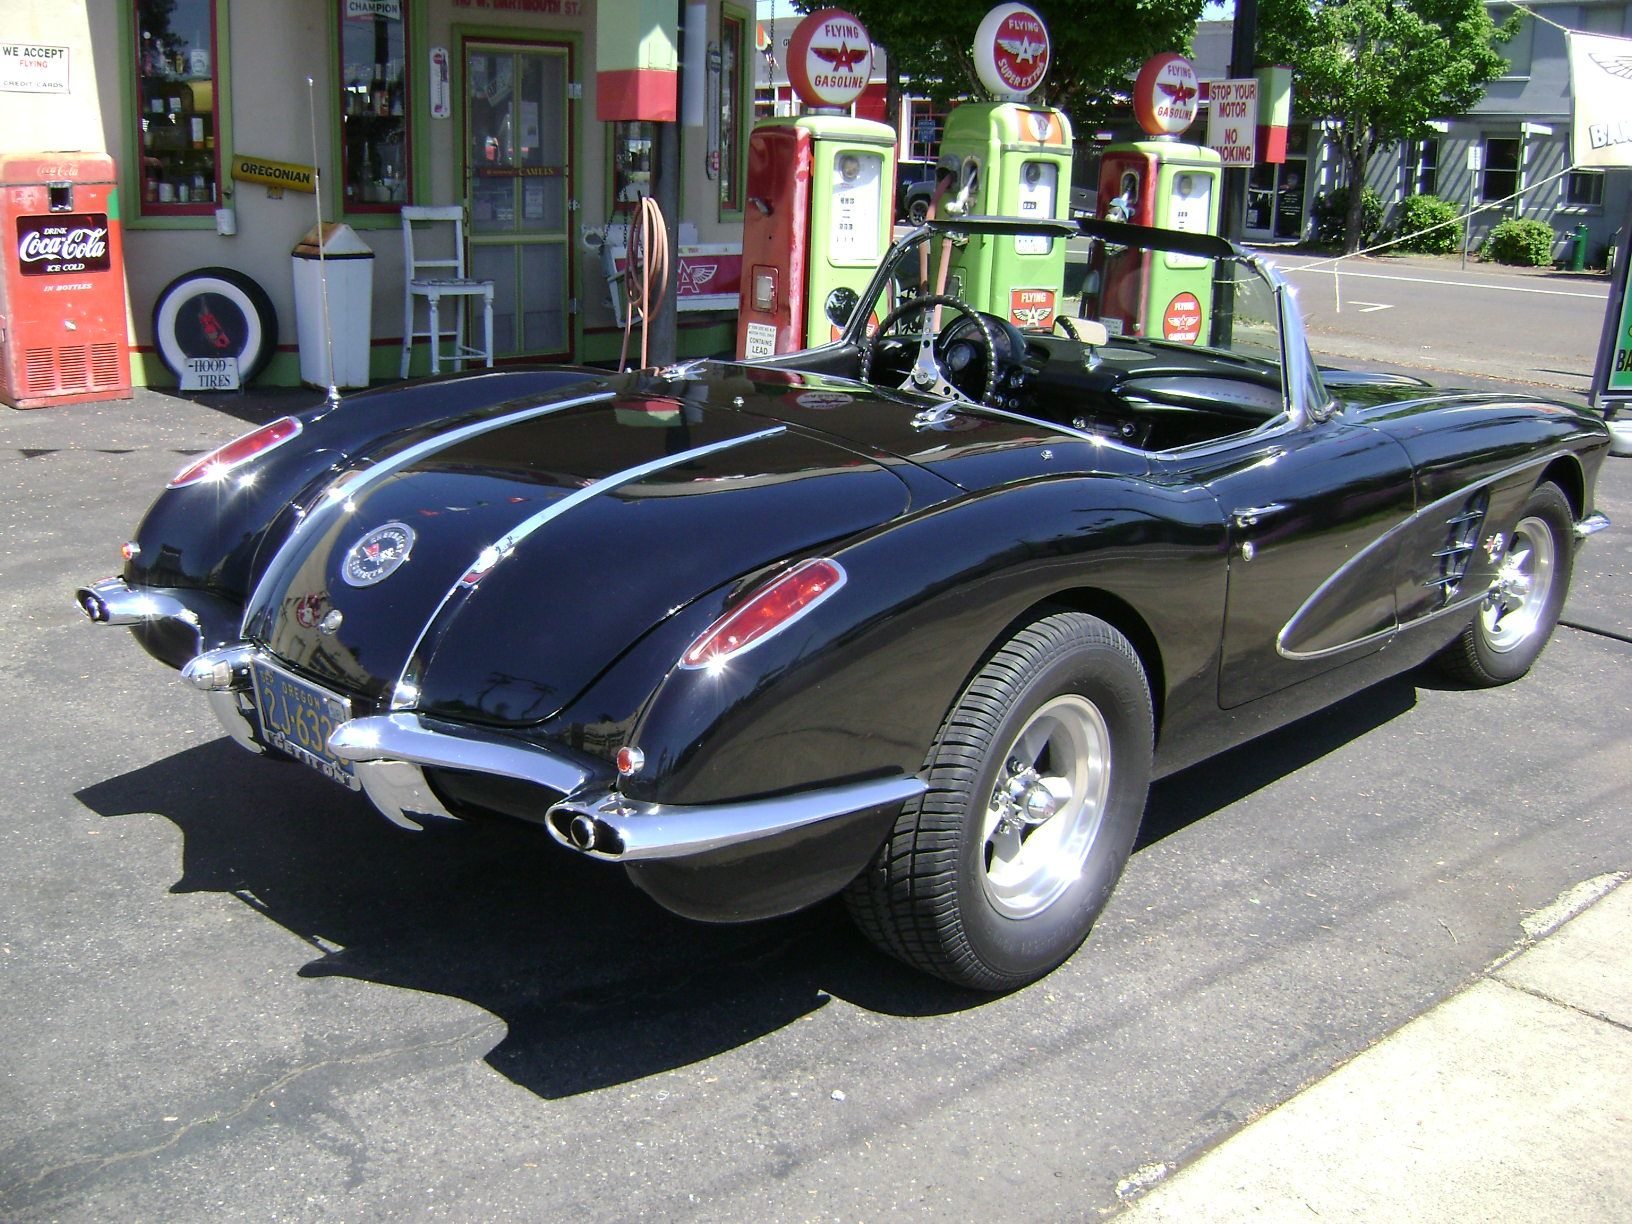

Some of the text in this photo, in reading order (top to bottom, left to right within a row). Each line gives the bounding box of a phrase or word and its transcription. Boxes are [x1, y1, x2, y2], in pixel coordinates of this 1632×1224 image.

[349, 1, 398, 13] CHAMPION
[825, 24, 859, 39] FLYING
[1008, 20, 1039, 32] FLYING
[3, 46, 64, 59] WE ACCEPT
[20, 60, 48, 69] FLYING
[1167, 64, 1191, 79] FLYING
[998, 58, 1045, 87] SUPER EXTRA
[814, 75, 864, 89] GASOLINE
[1211, 83, 1256, 100] STOP YOUR
[1157, 106, 1193, 121] GASOLINE
[1219, 101, 1246, 118] MOTOR
[1224, 128, 1238, 144] NO
[1589, 121, 1632, 149] BA
[1211, 146, 1251, 162] MOKING
[241, 162, 311, 184] OREGONIAN
[518, 167, 554, 176] CAMELS
[43, 227, 68, 235] DRINK
[20, 228, 107, 262] Coca-Cola
[46, 263, 85, 272] ICE COLD
[56, 283, 92, 291] BOTTLES
[1021, 292, 1046, 303] FLYING
[750, 337, 772, 346] CONTAINS
[752, 346, 768, 355] LEAD
[198, 375, 231, 387] TIRES
[282, 681, 320, 709] OREGON
[274, 738, 301, 759] GET
